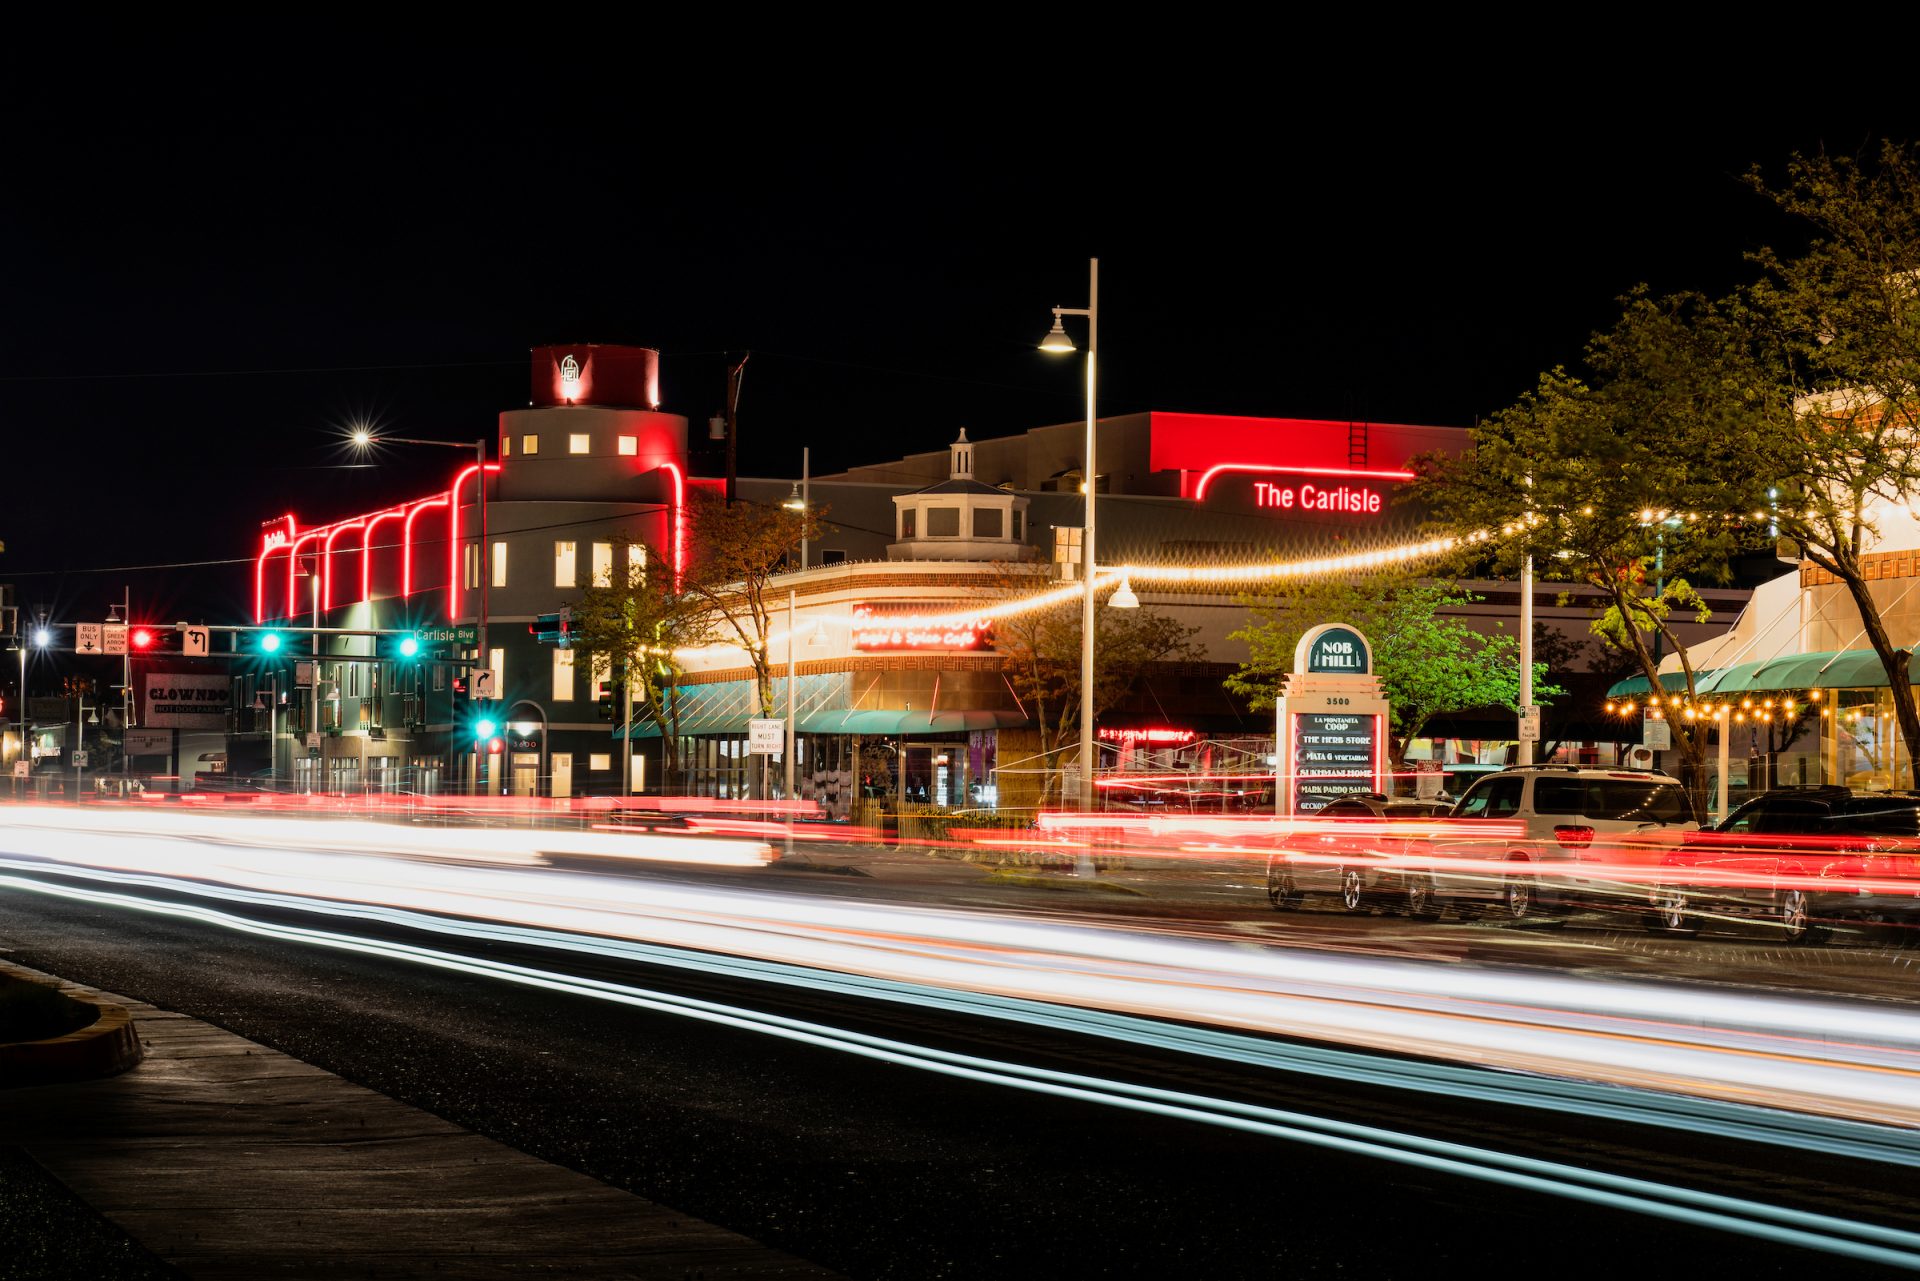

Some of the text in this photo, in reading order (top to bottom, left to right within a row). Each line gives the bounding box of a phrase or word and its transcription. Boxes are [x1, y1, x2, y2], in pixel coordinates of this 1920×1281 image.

[1254, 483, 1380, 512] The Carlisle
[416, 629, 474, 641] Carlisle Blvd
[1322, 641, 1353, 654] NOB
[1321, 655, 1355, 667] HILL
[1326, 697, 1350, 705] 3500
[1303, 735, 1371, 744] THE HERB STORE
[1306, 752, 1326, 760] MATA
[1327, 752, 1333, 760] G
[1300, 769, 1373, 778] SUKHMANI HOME
[1301, 785, 1323, 793] MARK
[1323, 785, 1348, 793] PARDO
